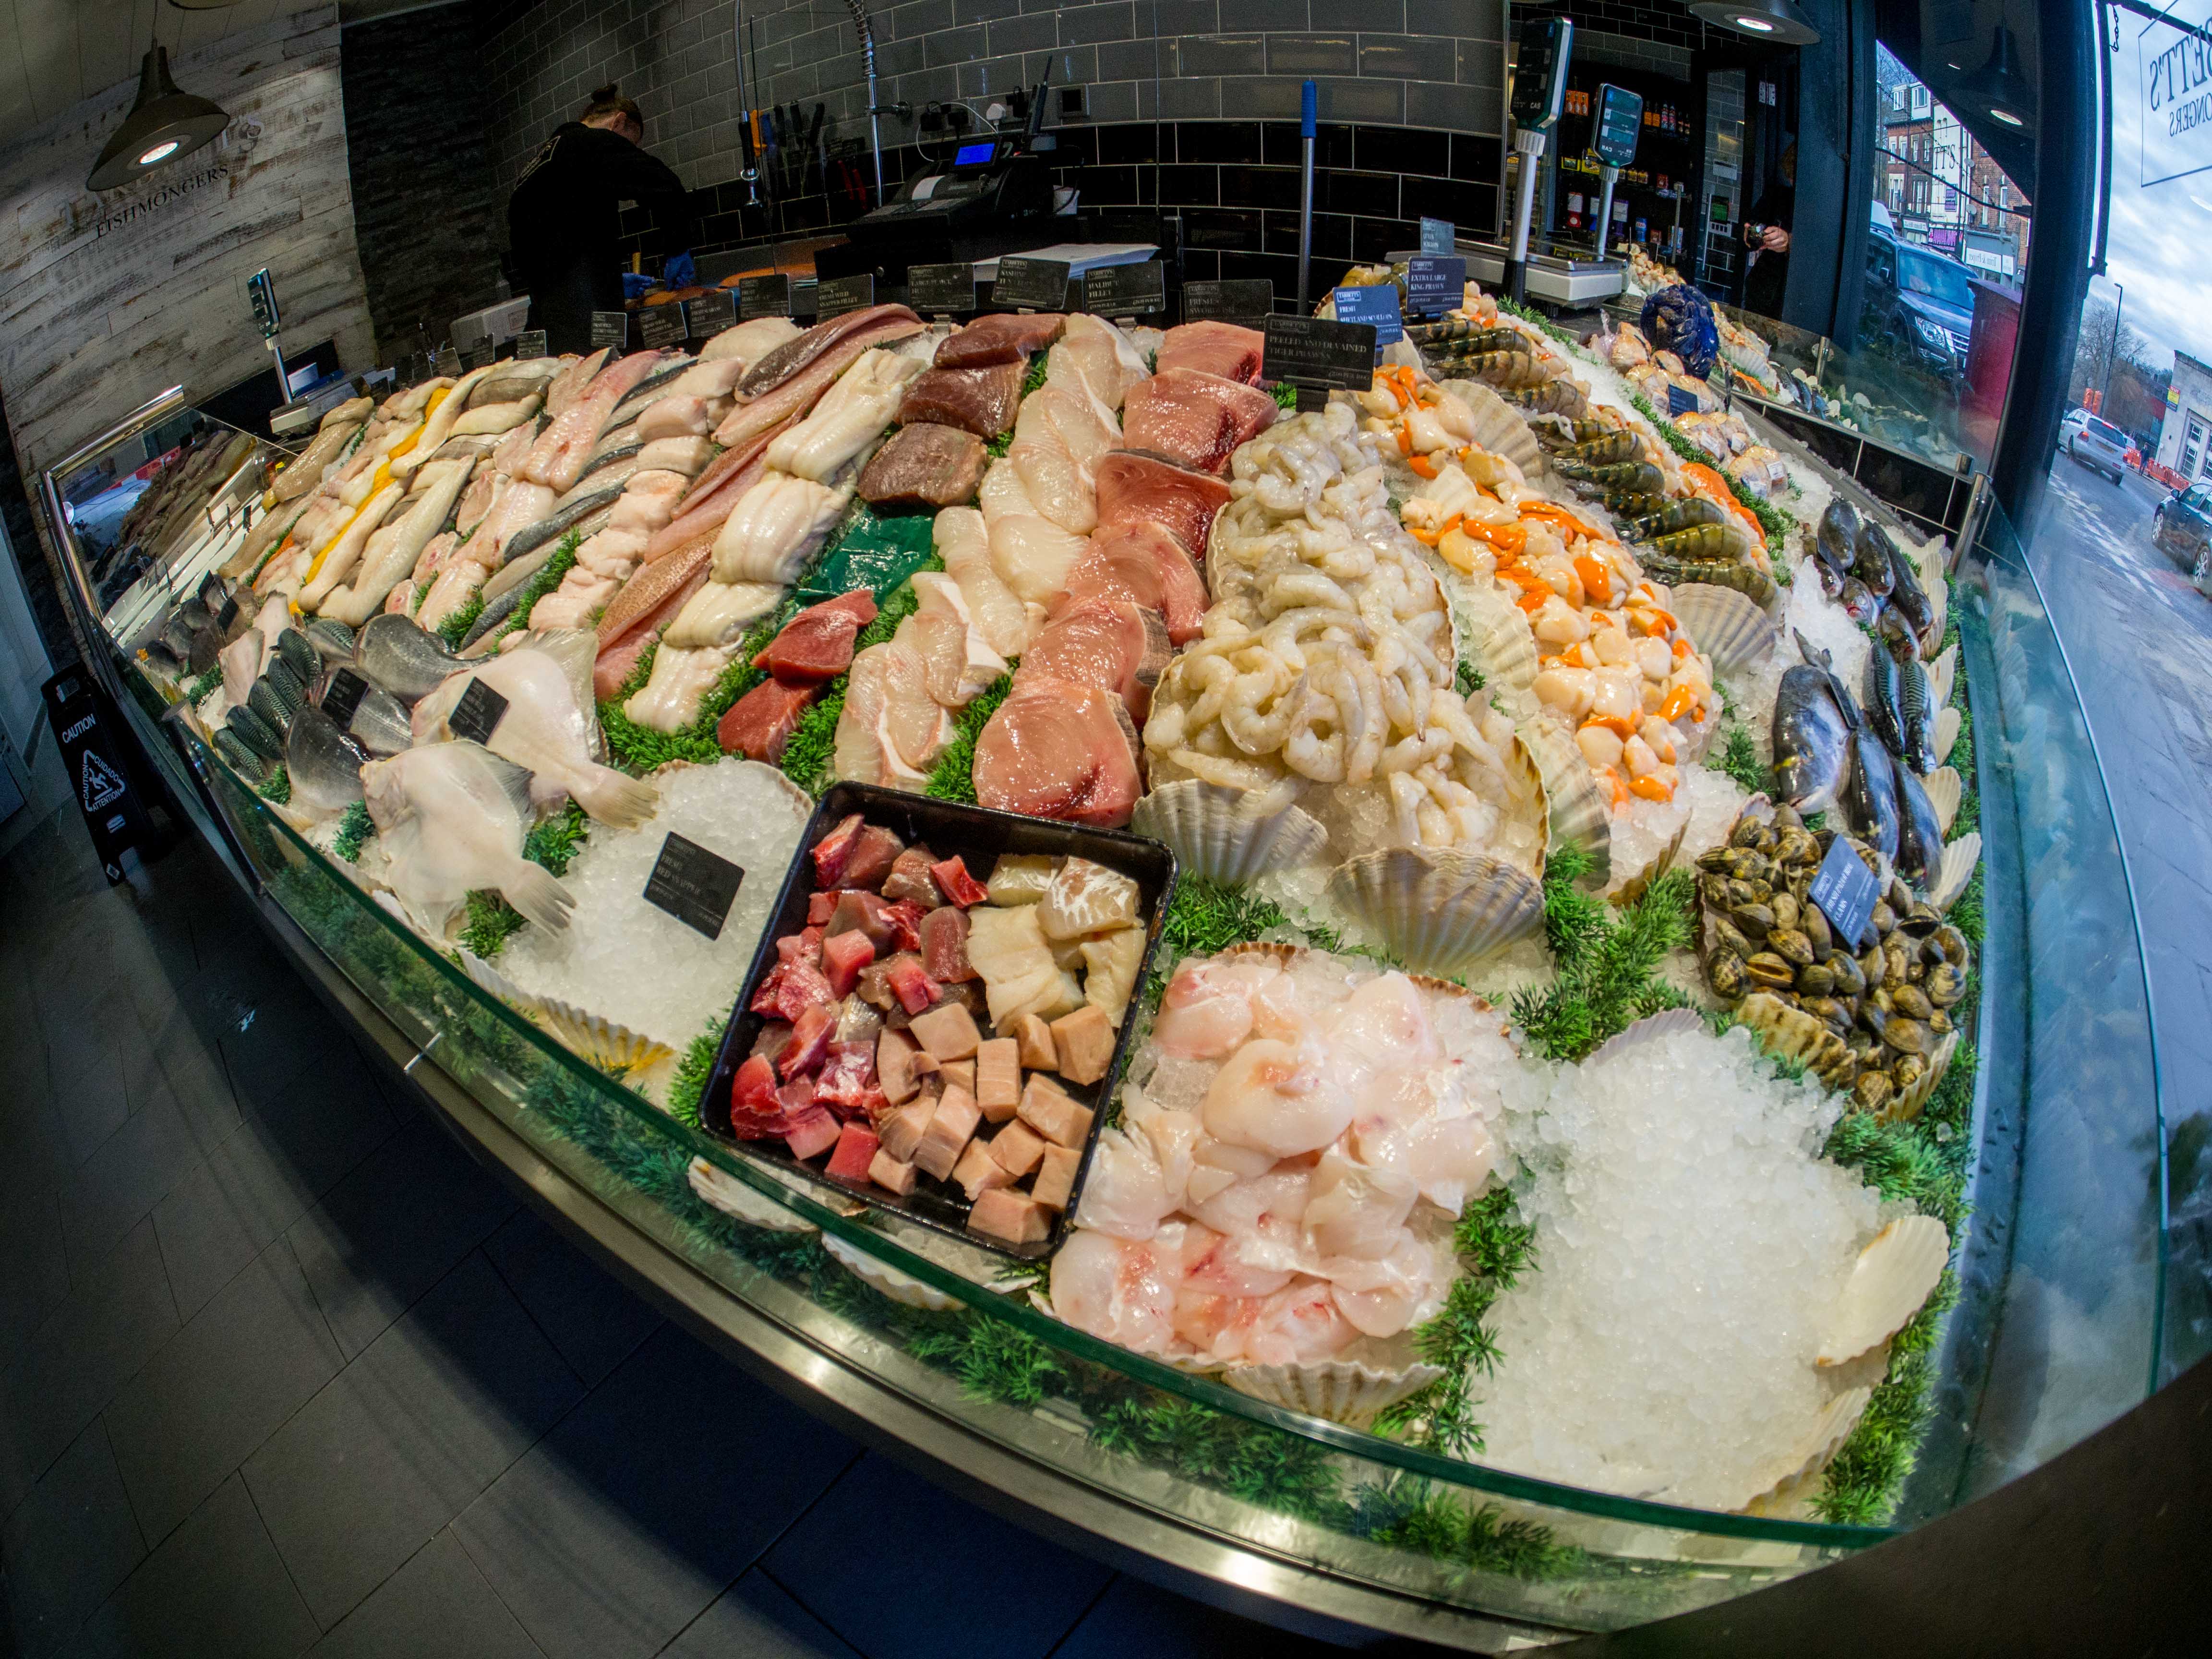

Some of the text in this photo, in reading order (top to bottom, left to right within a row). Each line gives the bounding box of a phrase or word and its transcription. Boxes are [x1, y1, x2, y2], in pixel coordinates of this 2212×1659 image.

[96, 163, 228, 239] FISHMONGERS
[62, 713, 96, 744] CAUTION
[94, 756, 119, 783] CUIDADO
[92, 789, 121, 812] ATTENTION
